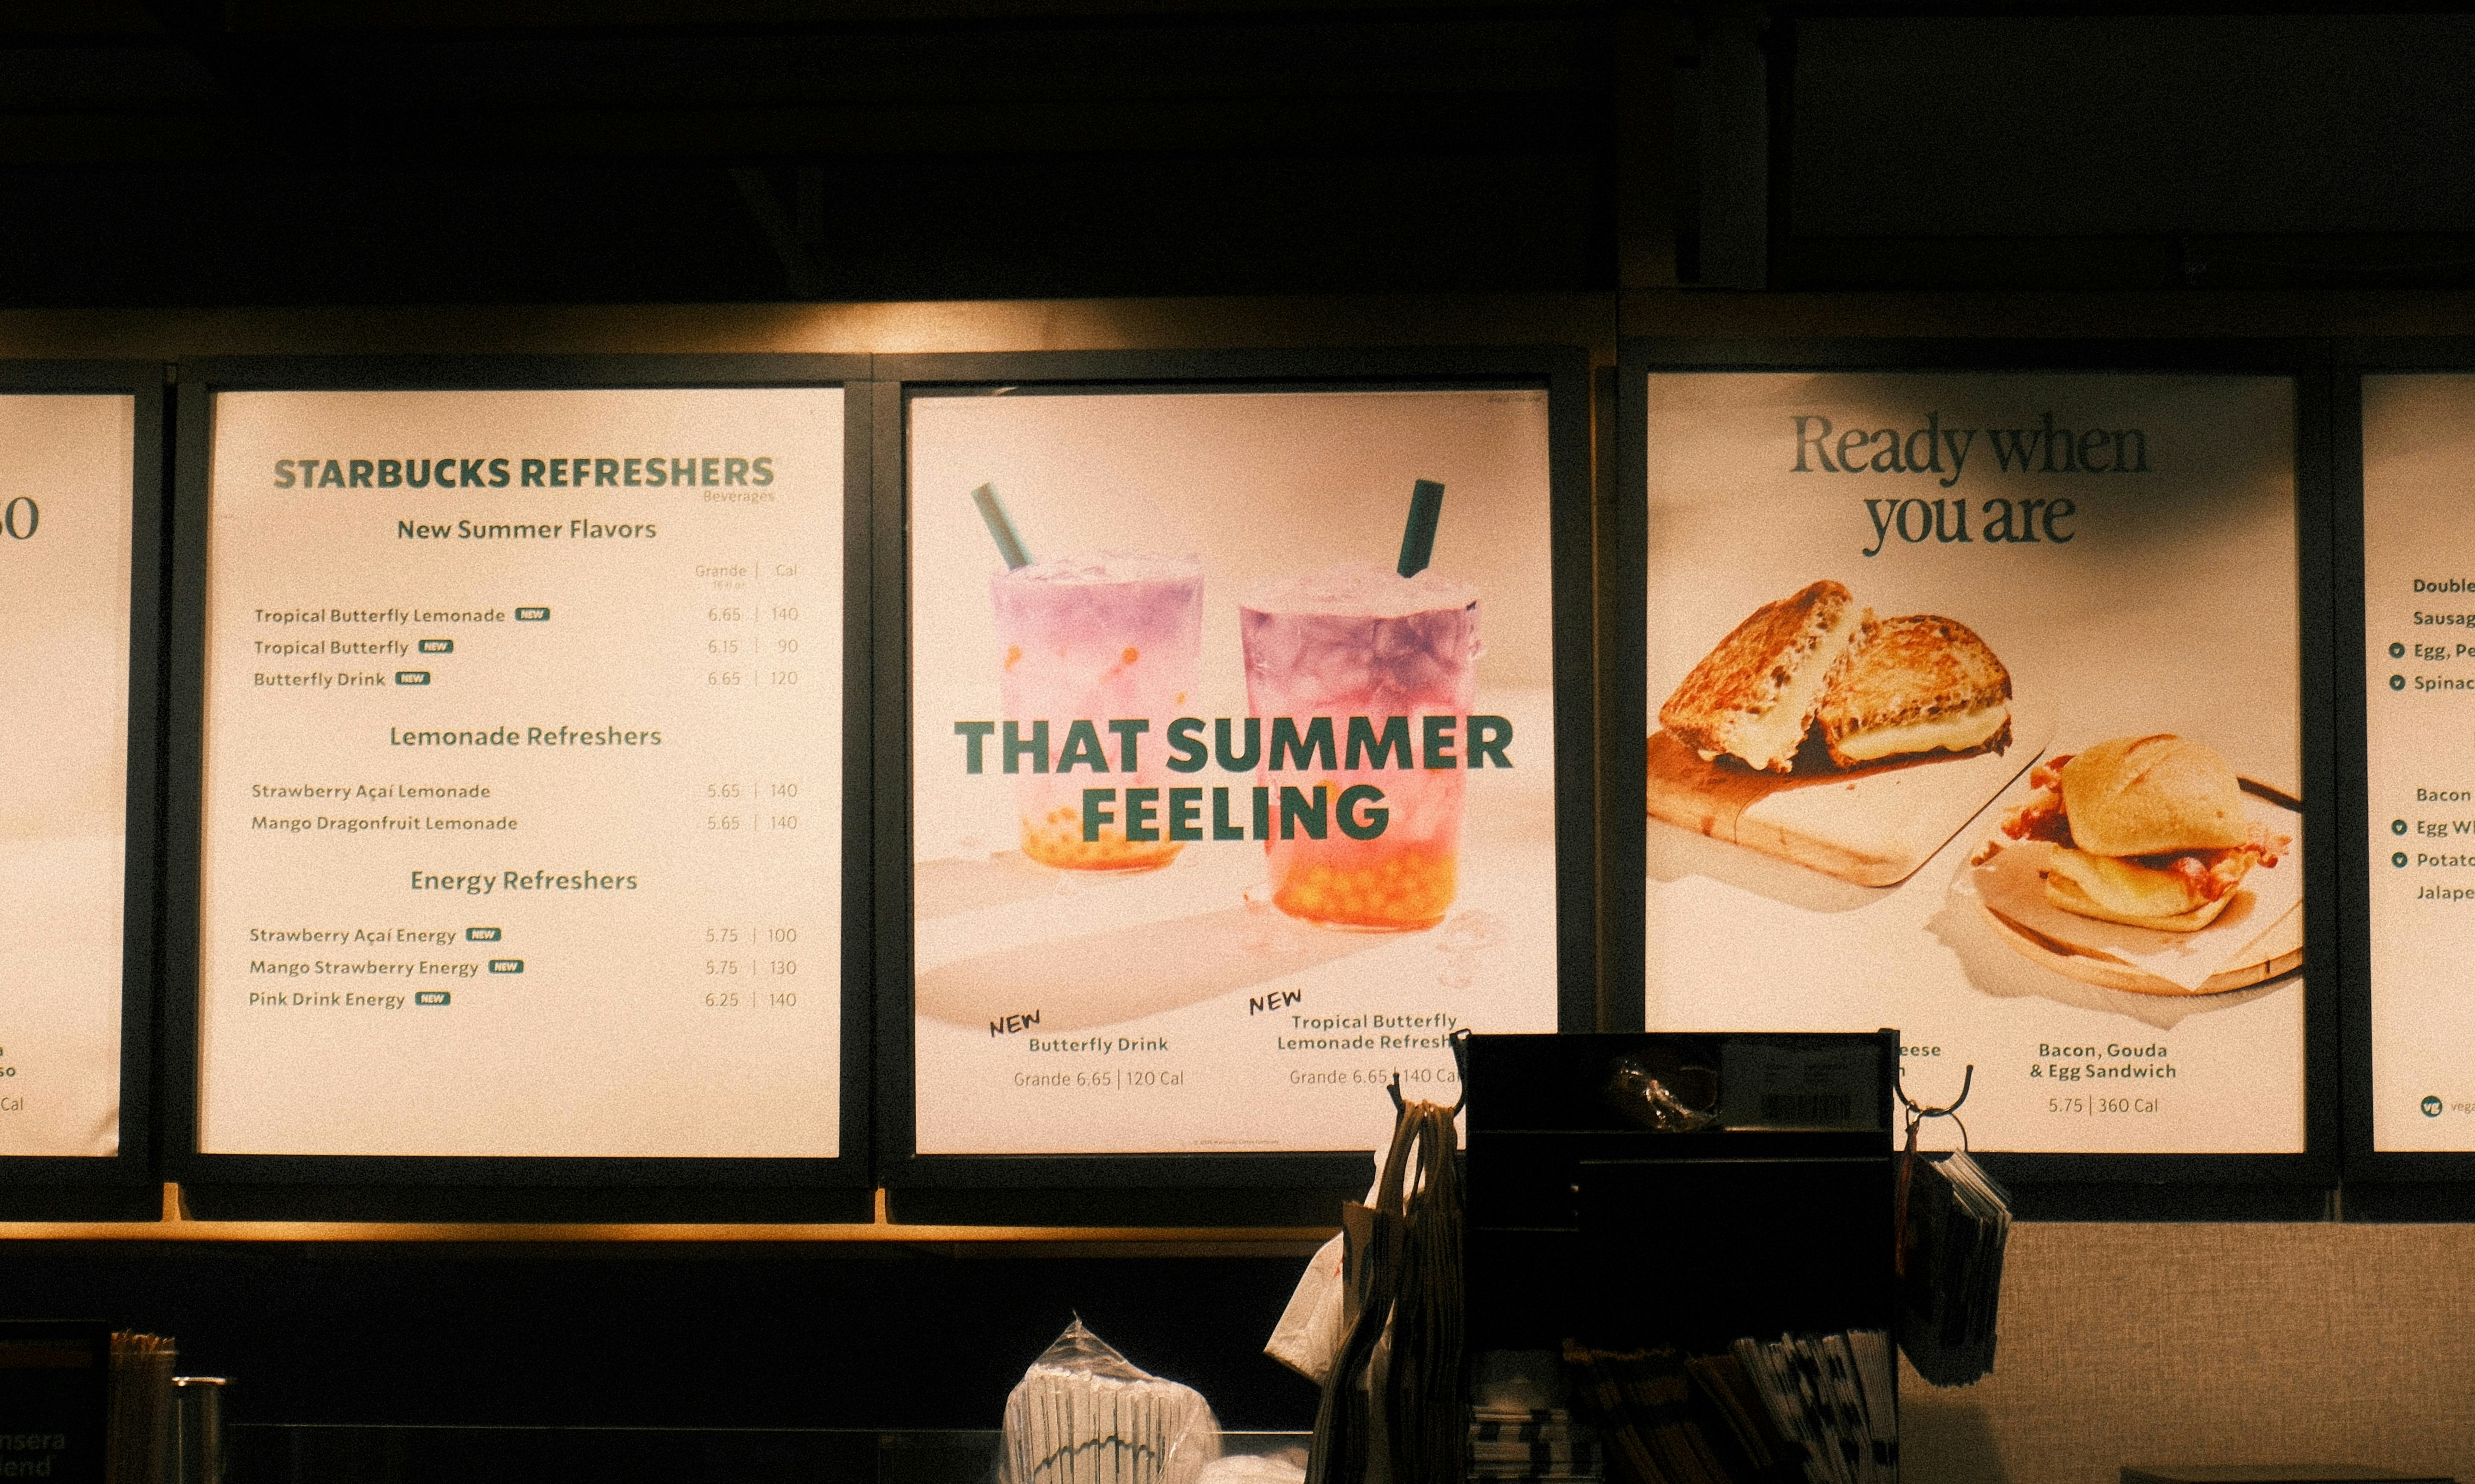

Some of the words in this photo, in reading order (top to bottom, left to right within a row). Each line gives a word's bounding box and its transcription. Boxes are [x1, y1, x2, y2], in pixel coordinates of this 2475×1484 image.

[1790, 413, 1976, 488] Ready
[1988, 412, 2151, 474] when
[274, 459, 510, 488] STARBUCKS
[522, 458, 774, 487] REFRESHERS
[703, 491, 774, 503] Beverages
[0, 497, 38, 539] o
[398, 521, 451, 539] New
[458, 521, 562, 539] Summer
[571, 519, 656, 539] Flavors
[1863, 498, 1972, 557] you
[1983, 497, 2076, 544] are
[695, 565, 746, 577] Grande
[776, 565, 797, 577] Cal
[2413, 579, 2475, 593] Double
[255, 609, 325, 624] Tropical
[331, 608, 409, 624] Butterfly
[414, 608, 505, 623] Lemonade
[708, 608, 741, 622] 6.65
[772, 608, 798, 621] 140
[254, 641, 325, 656] Tropical
[331, 641, 409, 657] Butterfly
[708, 640, 738, 654] 6.15
[779, 639, 798, 653] 90
[2415, 644, 2451, 661] Egg,
[254, 672, 333, 689] Butterfly
[338, 672, 385, 687] Drink
[708, 672, 741, 686] 6.65
[771, 672, 798, 686] 120
[2415, 676, 2475, 692] Spinac
[391, 727, 520, 746] Lemonade
[527, 727, 662, 746] Refreshers
[955, 718, 1151, 774] THAT
[1165, 716, 1514, 773] SUMMER
[251, 784, 351, 802] Strawberry
[356, 784, 393, 802] Açaí
[399, 784, 491, 799] Lemonade
[708, 784, 740, 799] 5.65
[771, 784, 797, 798] 140
[2417, 789, 2471, 802] Bacon
[1082, 784, 1389, 843] FEELING
[251, 816, 311, 833] Mango
[317, 815, 420, 833] Dragonfruit
[426, 815, 517, 831] Lemonade
[707, 816, 740, 831] 5.65
[770, 816, 797, 830] 140
[2417, 821, 2448, 838] Egg
[411, 871, 495, 894] Energy
[504, 871, 637, 890] Refreshers
[2418, 886, 2475, 902] Jalape
[250, 928, 349, 945] Strawberry
[354, 927, 392, 945] Açaí
[397, 928, 457, 945] Energy
[706, 928, 738, 942] 5.75
[768, 928, 797, 942] 100
[250, 960, 310, 977] Mango
[315, 960, 414, 977] Strawberry
[419, 960, 479, 978] Energy
[706, 960, 738, 975] 5.75
[770, 960, 797, 975] 130
[249, 992, 287, 1007] Pink
[293, 992, 341, 1007] Drink
[346, 992, 406, 1010] Energy
[705, 993, 738, 1007] 6.25
[770, 992, 797, 1007] 140
[1249, 989, 1301, 1016] NEW
[990, 1010, 1040, 1037] NEW
[1292, 1015, 1367, 1031] Tropical
[1374, 1014, 1457, 1029] Butterfly
[1029, 1038, 1112, 1054] Butterfly
[1119, 1037, 1168, 1051] Drink
[1278, 1036, 1374, 1050] Lemonade
[2039, 1044, 2101, 1060] Bacon,
[2108, 1044, 2167, 1057] Gouda
[1015, 1072, 1070, 1086] Grande
[1077, 1072, 1111, 1086] 6.65
[1128, 1071, 1154, 1085] 120
[1161, 1071, 1183, 1085] Cal
[1291, 1070, 1346, 1084] Grande
[1353, 1070, 1386, 1083] 6.65
[1405, 1069, 1431, 1083] 140
[2030, 1065, 2042, 1077] &
[2050, 1065, 2080, 1081] Egg
[2086, 1064, 2176, 1078] Sandwich
[1, 1097, 23, 1110] Cal
[2049, 1099, 2083, 1112] 5.75
[2099, 1099, 2129, 1112] 360
[2135, 1099, 2158, 1112] Cal
